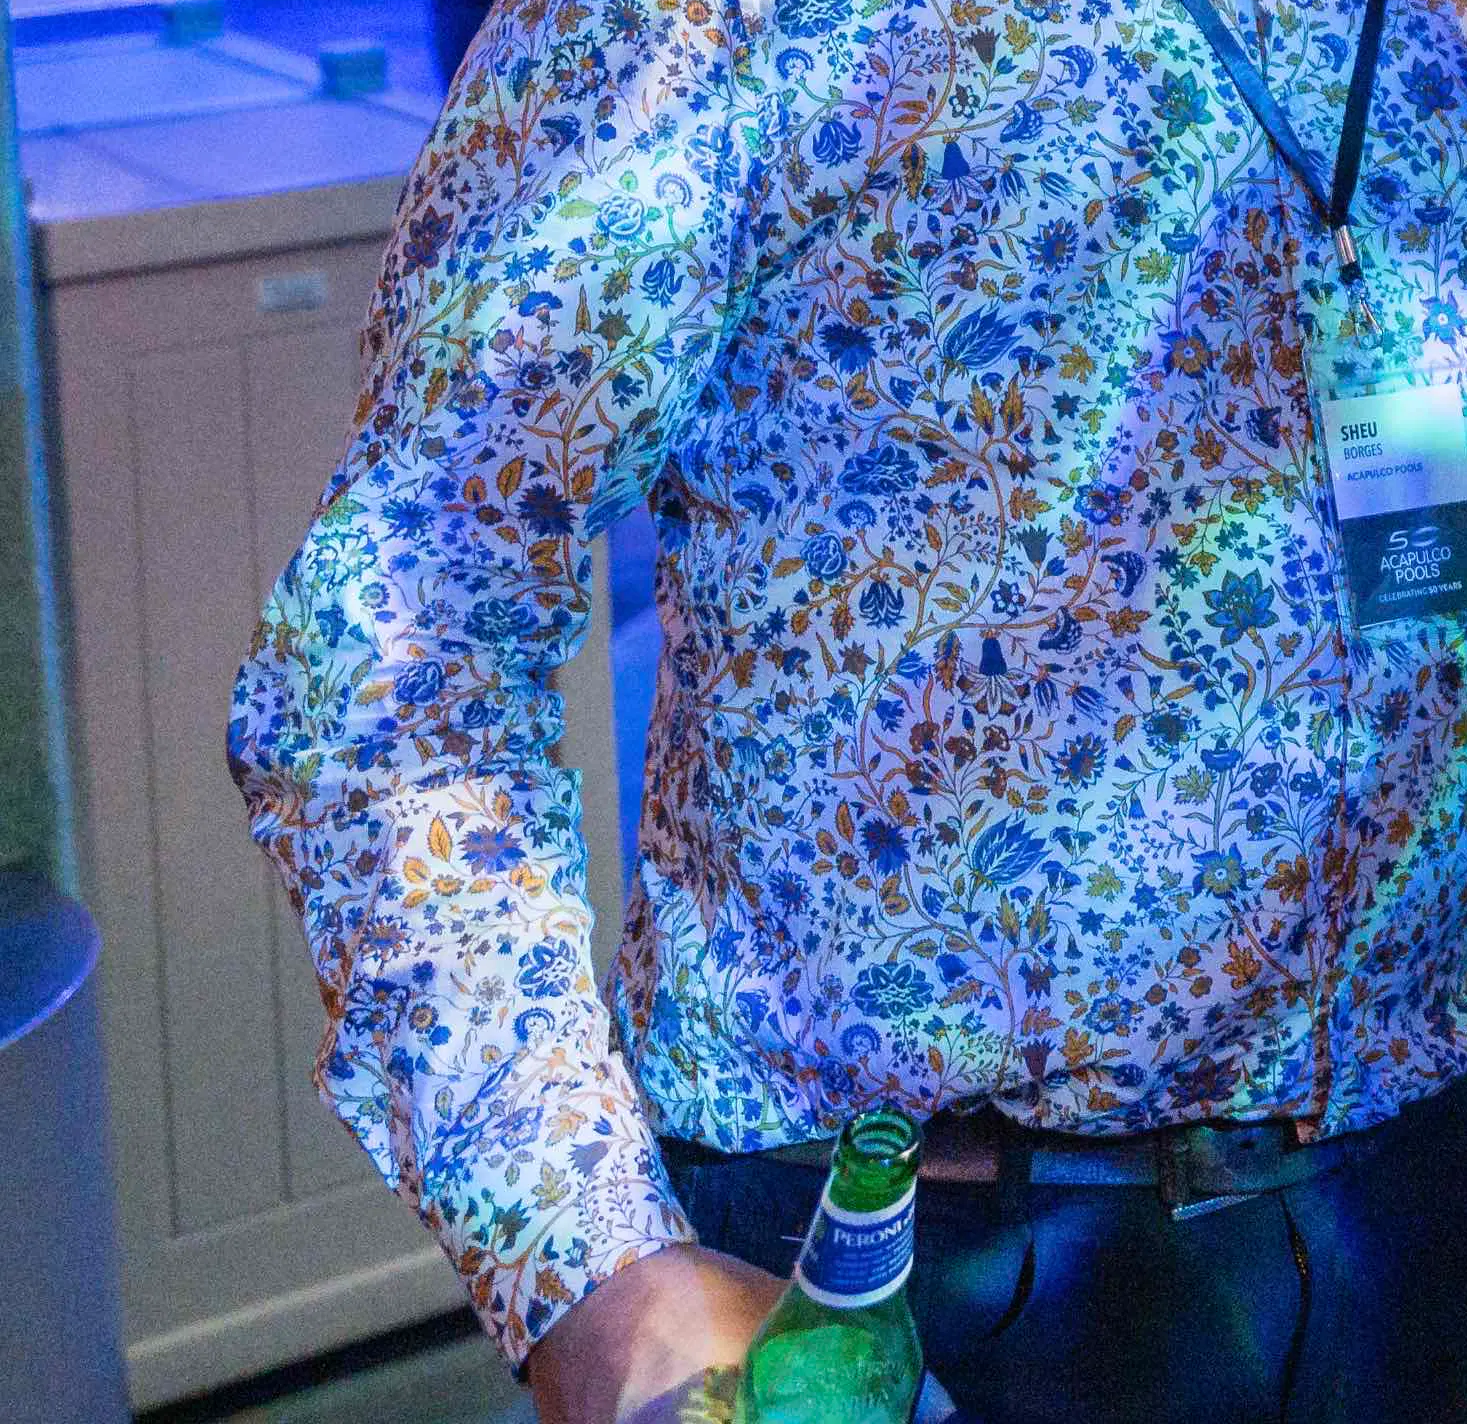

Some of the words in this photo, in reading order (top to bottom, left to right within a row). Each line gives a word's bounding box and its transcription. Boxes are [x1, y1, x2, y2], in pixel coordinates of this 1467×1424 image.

[1341, 421, 1378, 442] SHEU
[1344, 442, 1384, 460] BORGES
[1347, 466, 1394, 481] ACAPULCO
[1395, 462, 1424, 474] POOLS
[1381, 546, 1452, 573] ACAPULCO
[1395, 563, 1441, 584] POOLS
[1439, 580, 1463, 593] YEARS
[833, 1220, 902, 1249] PERONI
